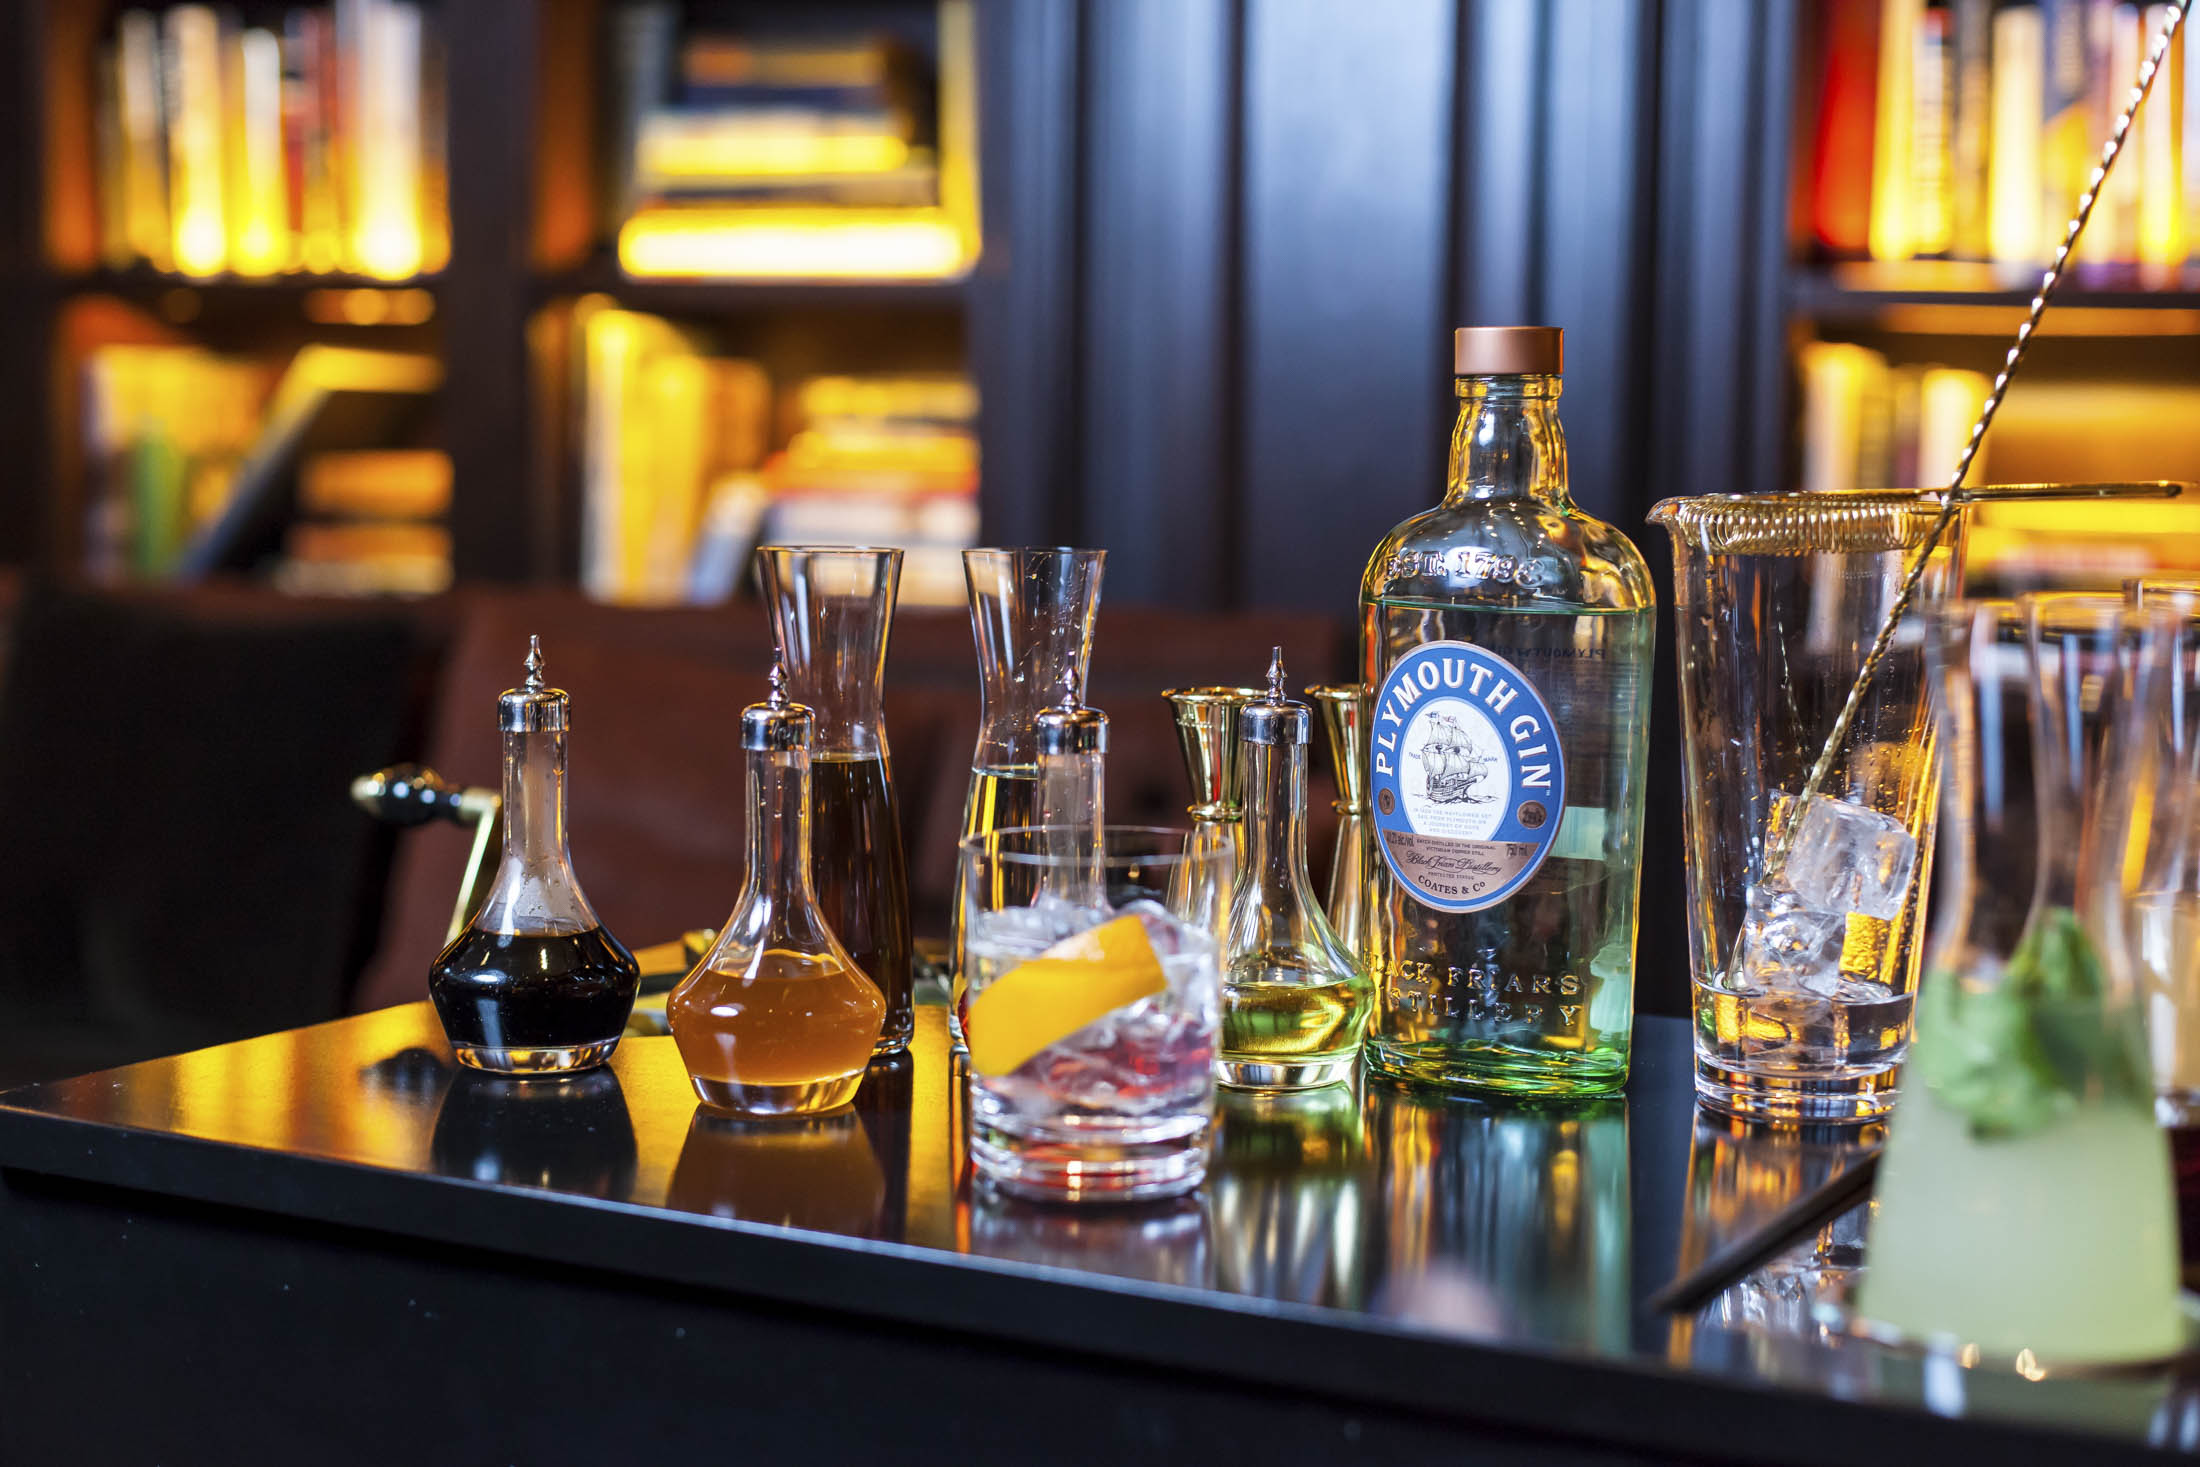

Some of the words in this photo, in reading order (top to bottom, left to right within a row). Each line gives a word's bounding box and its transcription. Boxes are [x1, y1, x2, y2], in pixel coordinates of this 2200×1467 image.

[1375, 658, 1519, 777] PLYMOUTH
[1510, 714, 1552, 788] GIN
[1418, 874, 1458, 895] COATES
[1461, 886, 1470, 894] &
